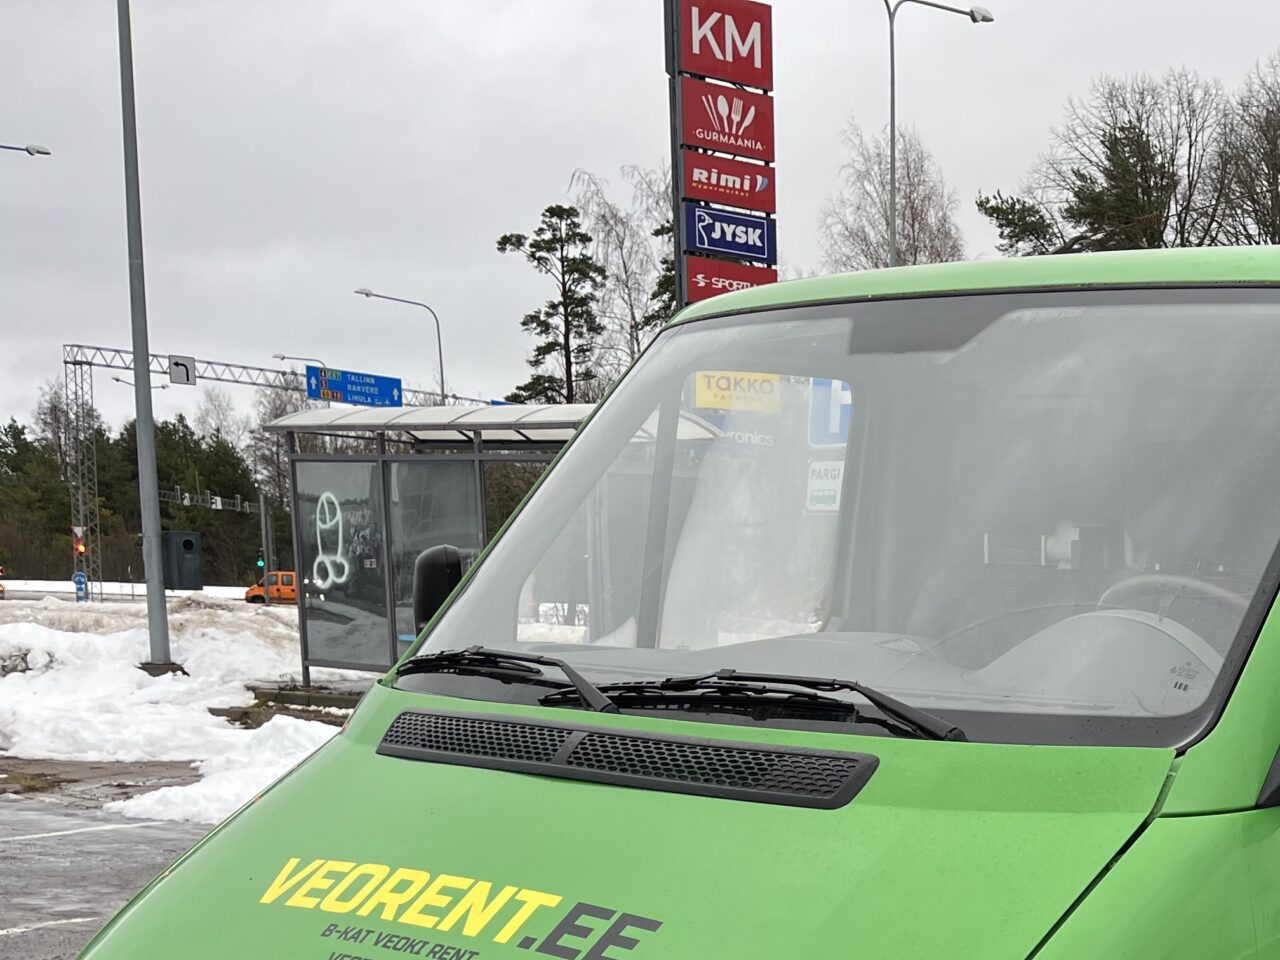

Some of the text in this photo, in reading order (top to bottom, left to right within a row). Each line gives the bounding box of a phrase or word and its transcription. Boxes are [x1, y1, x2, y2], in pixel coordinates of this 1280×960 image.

[691, 6, 762, 69] KM
[695, 128, 763, 151] GURMAANIA
[692, 168, 750, 191] Rimi
[711, 221, 763, 247] JYSK
[347, 374, 375, 384] TALLINN
[347, 384, 379, 394] RAKVERE
[320, 923, 375, 946] B-KAT
[373, 931, 428, 956] VEOKI
